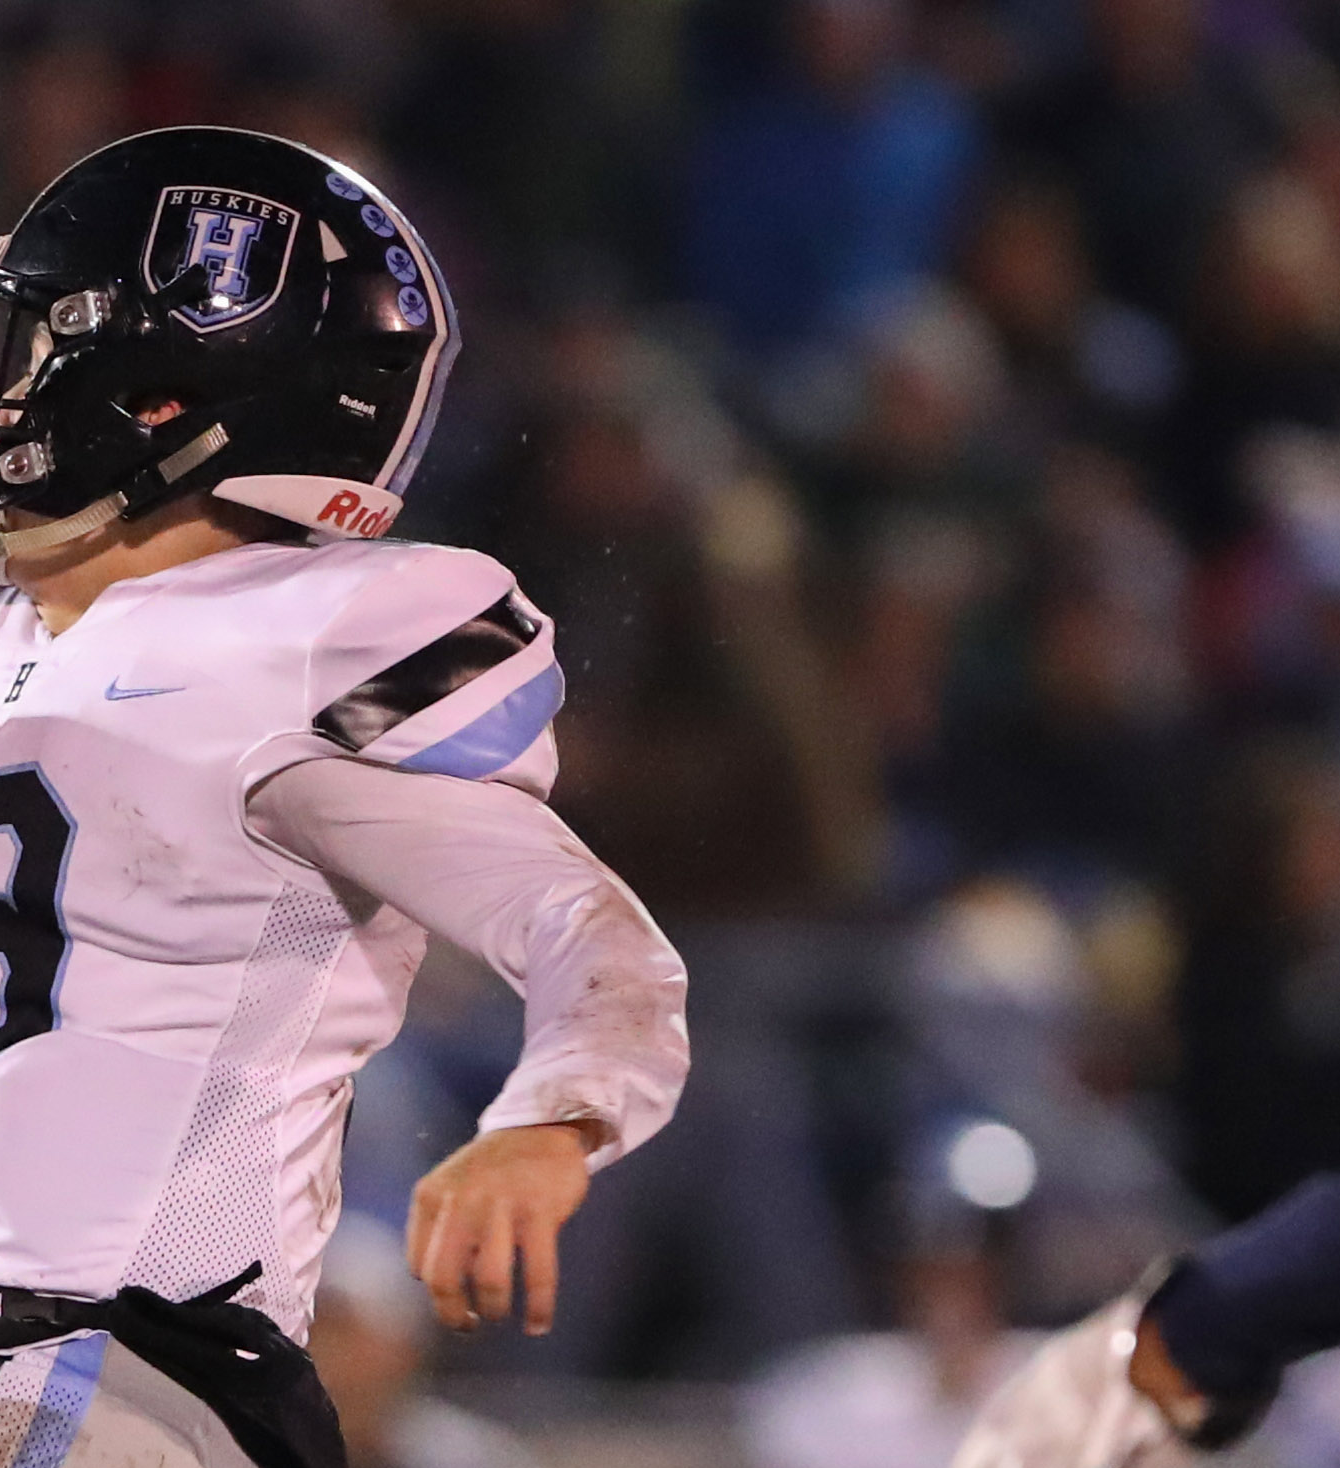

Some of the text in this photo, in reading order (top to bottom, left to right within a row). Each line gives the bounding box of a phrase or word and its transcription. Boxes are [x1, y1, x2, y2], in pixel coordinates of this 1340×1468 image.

[170, 191, 289, 225] HUSKIES
[175, 207, 264, 300] H
[339, 394, 376, 416] Riddell
[4, 661, 38, 703] H
